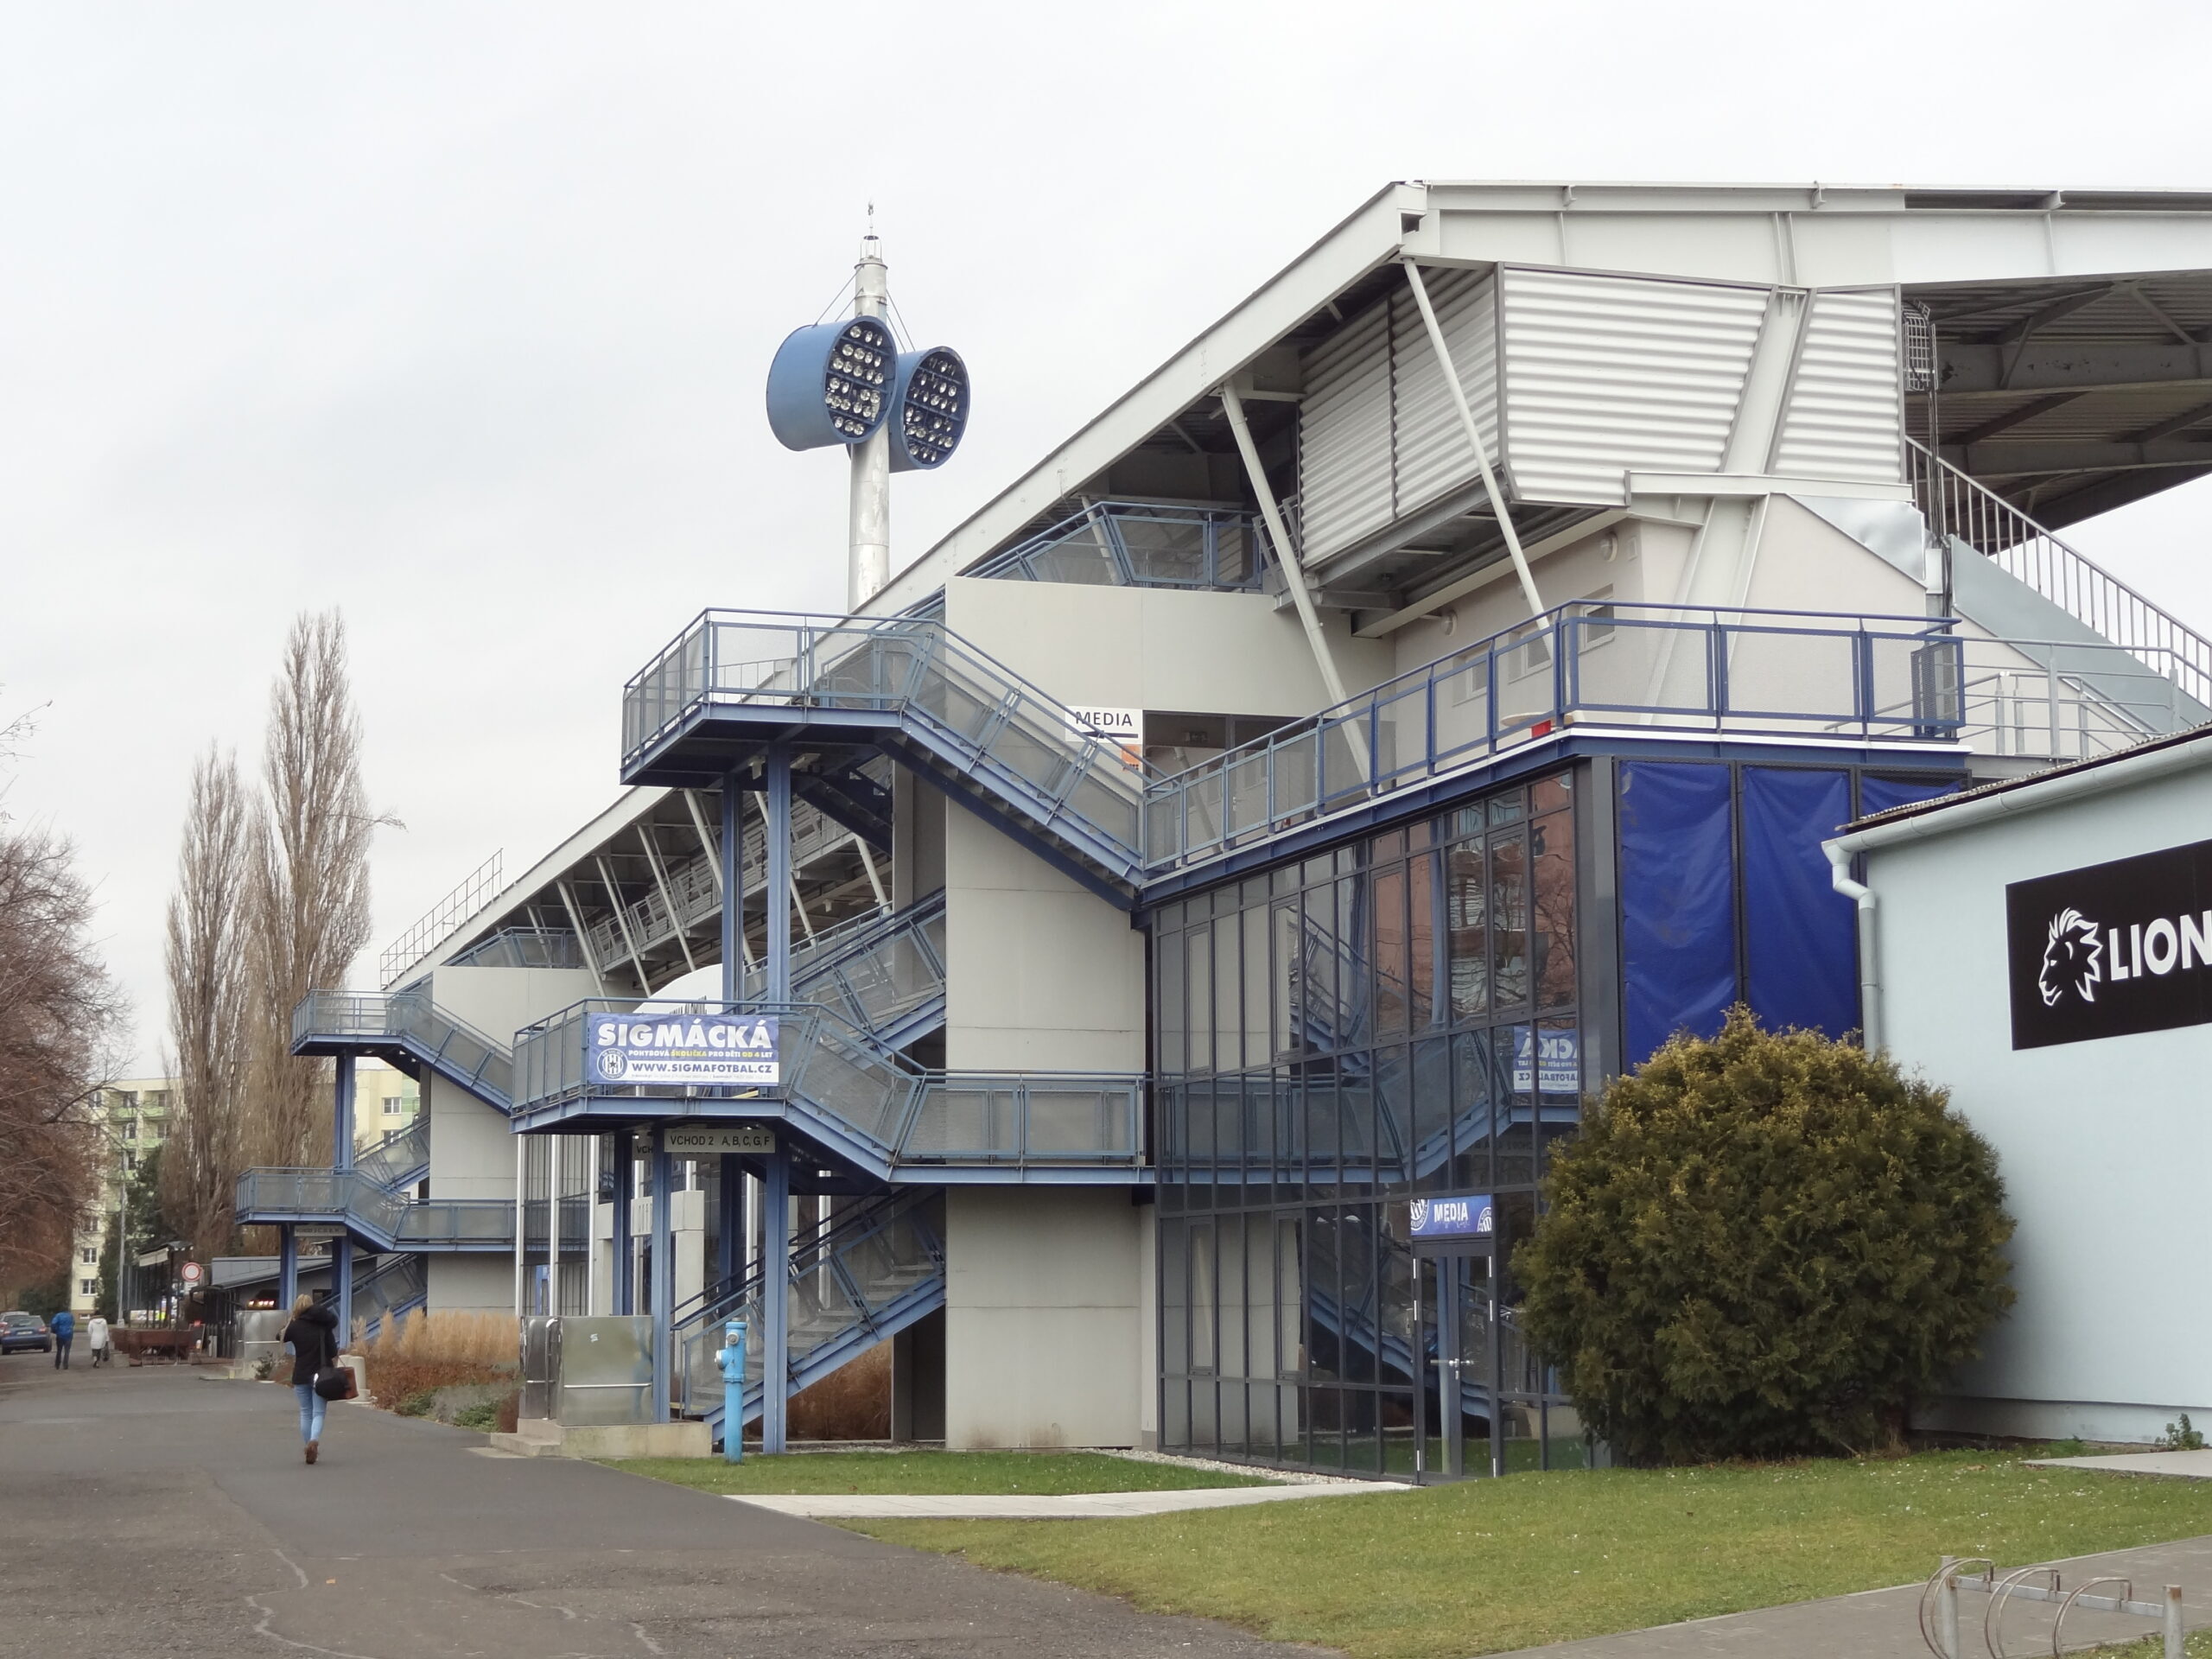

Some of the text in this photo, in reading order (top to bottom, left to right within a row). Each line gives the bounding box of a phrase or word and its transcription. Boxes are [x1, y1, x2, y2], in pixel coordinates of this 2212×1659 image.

[1076, 711, 1133, 727] MEDIA
[598, 1018, 772, 1049] SIGMÁCKÁ
[725, 1049, 741, 1058] DĚTI
[632, 1063, 772, 1073] WWW.SIGMAFOTBAL.CZ
[671, 1135, 706, 1146] VCHOD
[708, 1135, 714, 1146] 2
[1434, 1202, 1469, 1223] MEDIA
